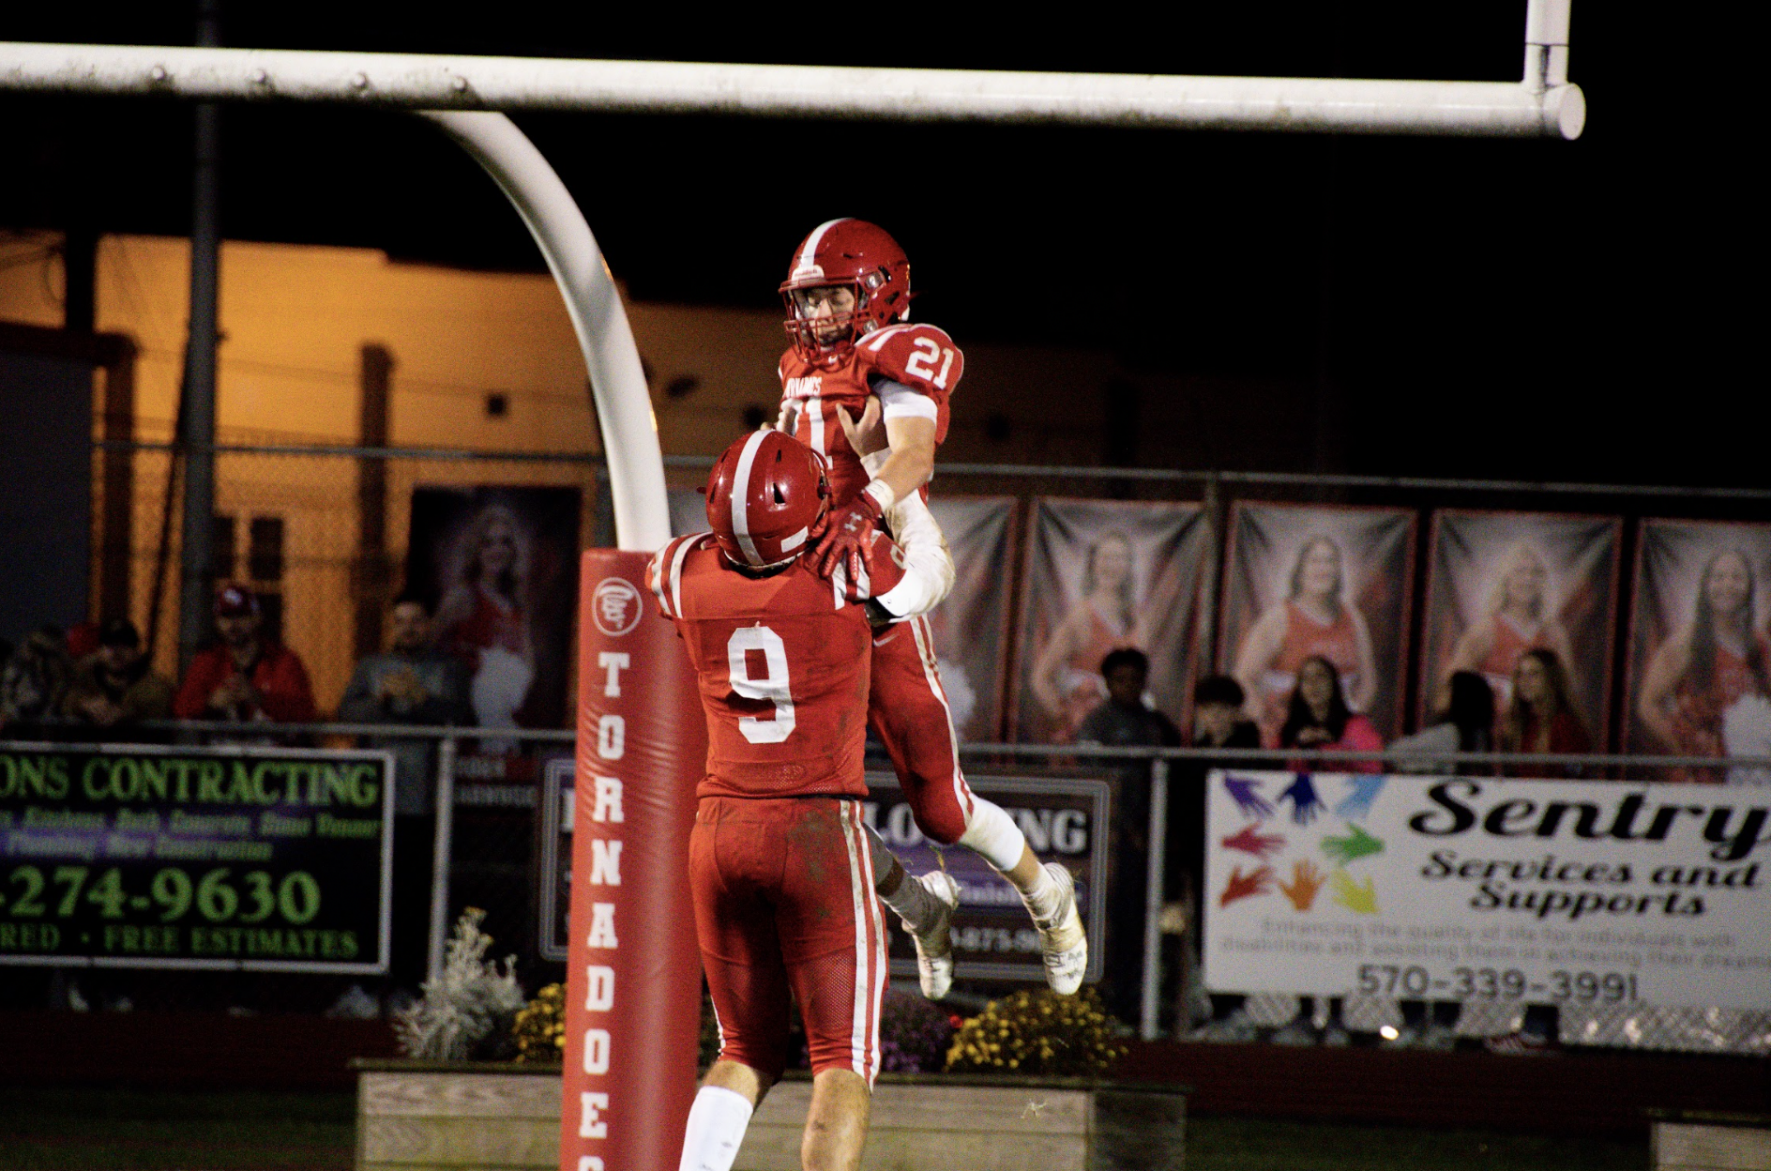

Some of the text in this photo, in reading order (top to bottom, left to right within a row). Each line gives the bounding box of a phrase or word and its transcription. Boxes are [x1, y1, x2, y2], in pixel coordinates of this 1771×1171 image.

[905, 336, 954, 389] 21
[728, 625, 797, 745] 9
[81, 757, 379, 807] CONTRACTING
[1407, 777, 1771, 861] Sentry
[0, 864, 321, 924] 274-9630
[1420, 849, 1763, 889] Services and
[1469, 880, 1706, 922] Supports
[103, 924, 180, 953] FREE
[190, 926, 360, 959] ESTIMATES
[1357, 964, 1638, 1003] 570-339-3991
